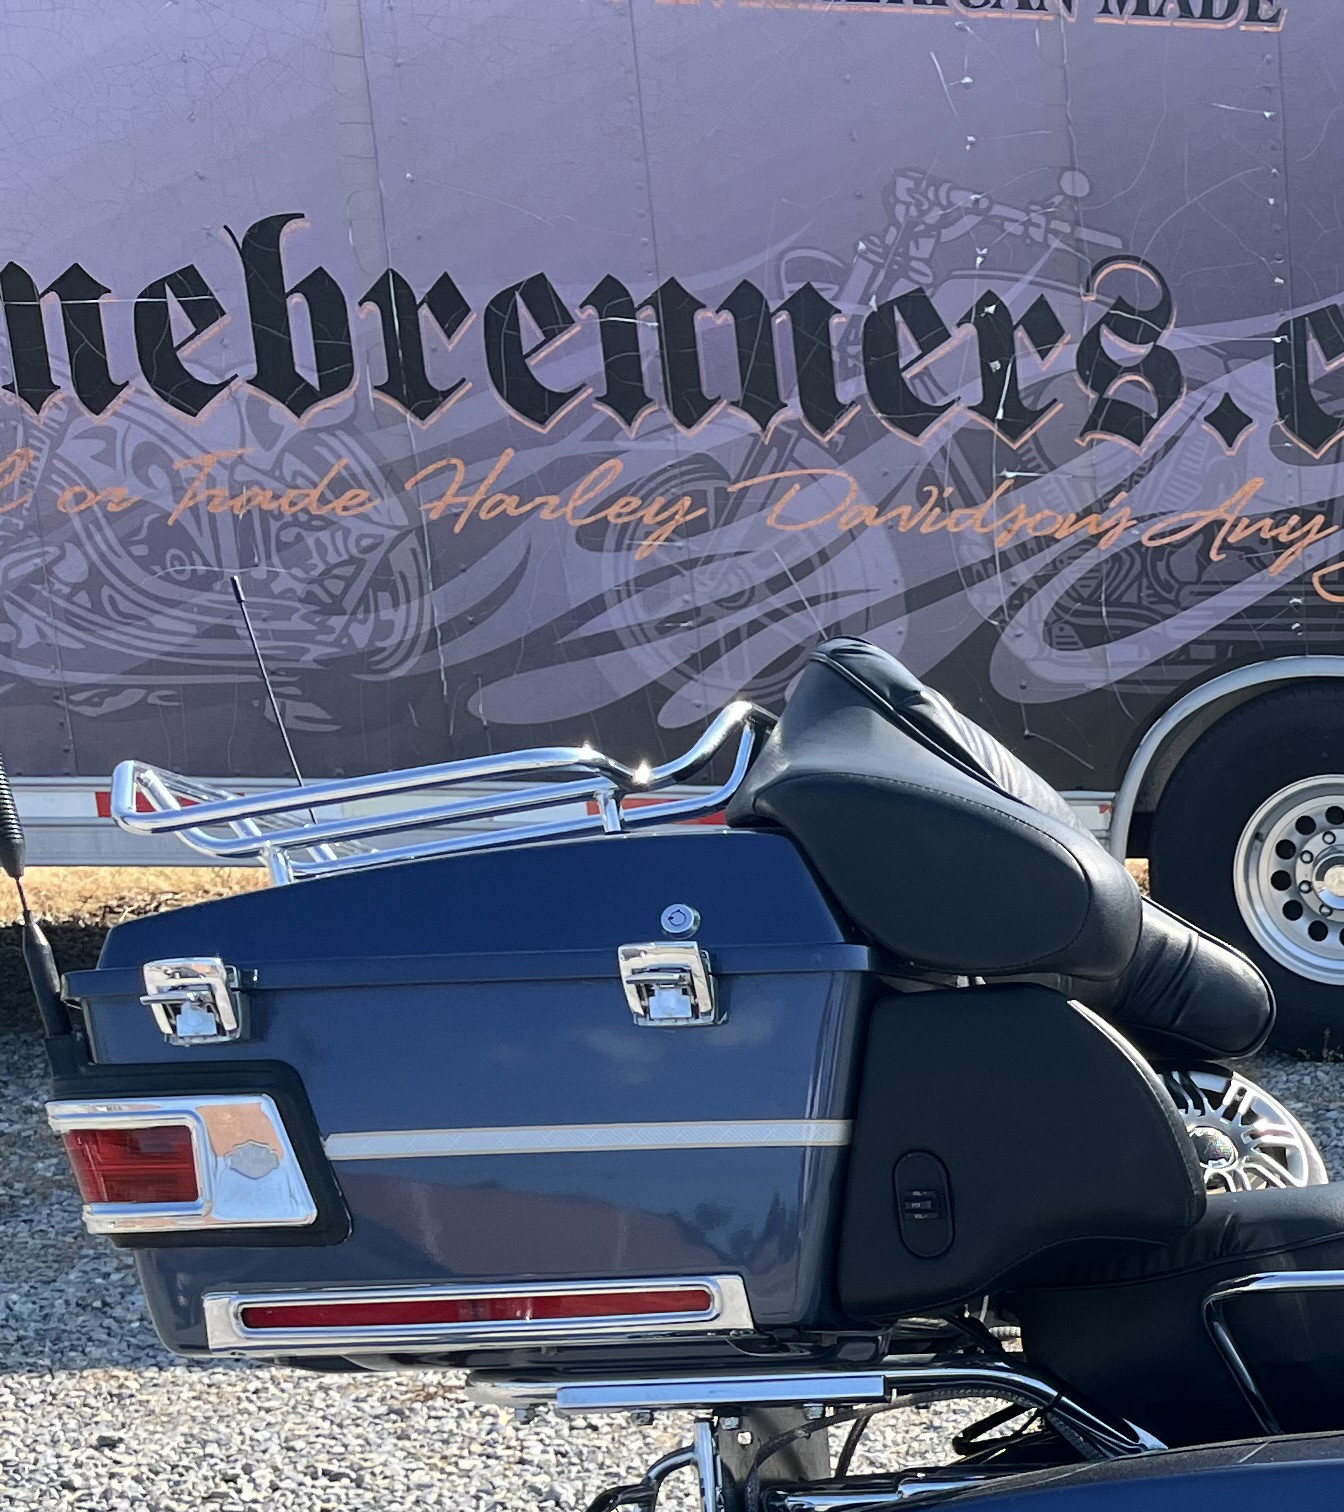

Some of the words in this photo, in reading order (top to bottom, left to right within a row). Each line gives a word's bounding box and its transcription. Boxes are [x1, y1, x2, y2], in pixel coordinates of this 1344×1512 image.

[57, 484, 141, 513] or
[167, 448, 382, 527] Trade
[404, 447, 708, 560] Harley
[1141, 475, 1339, 577] Any
